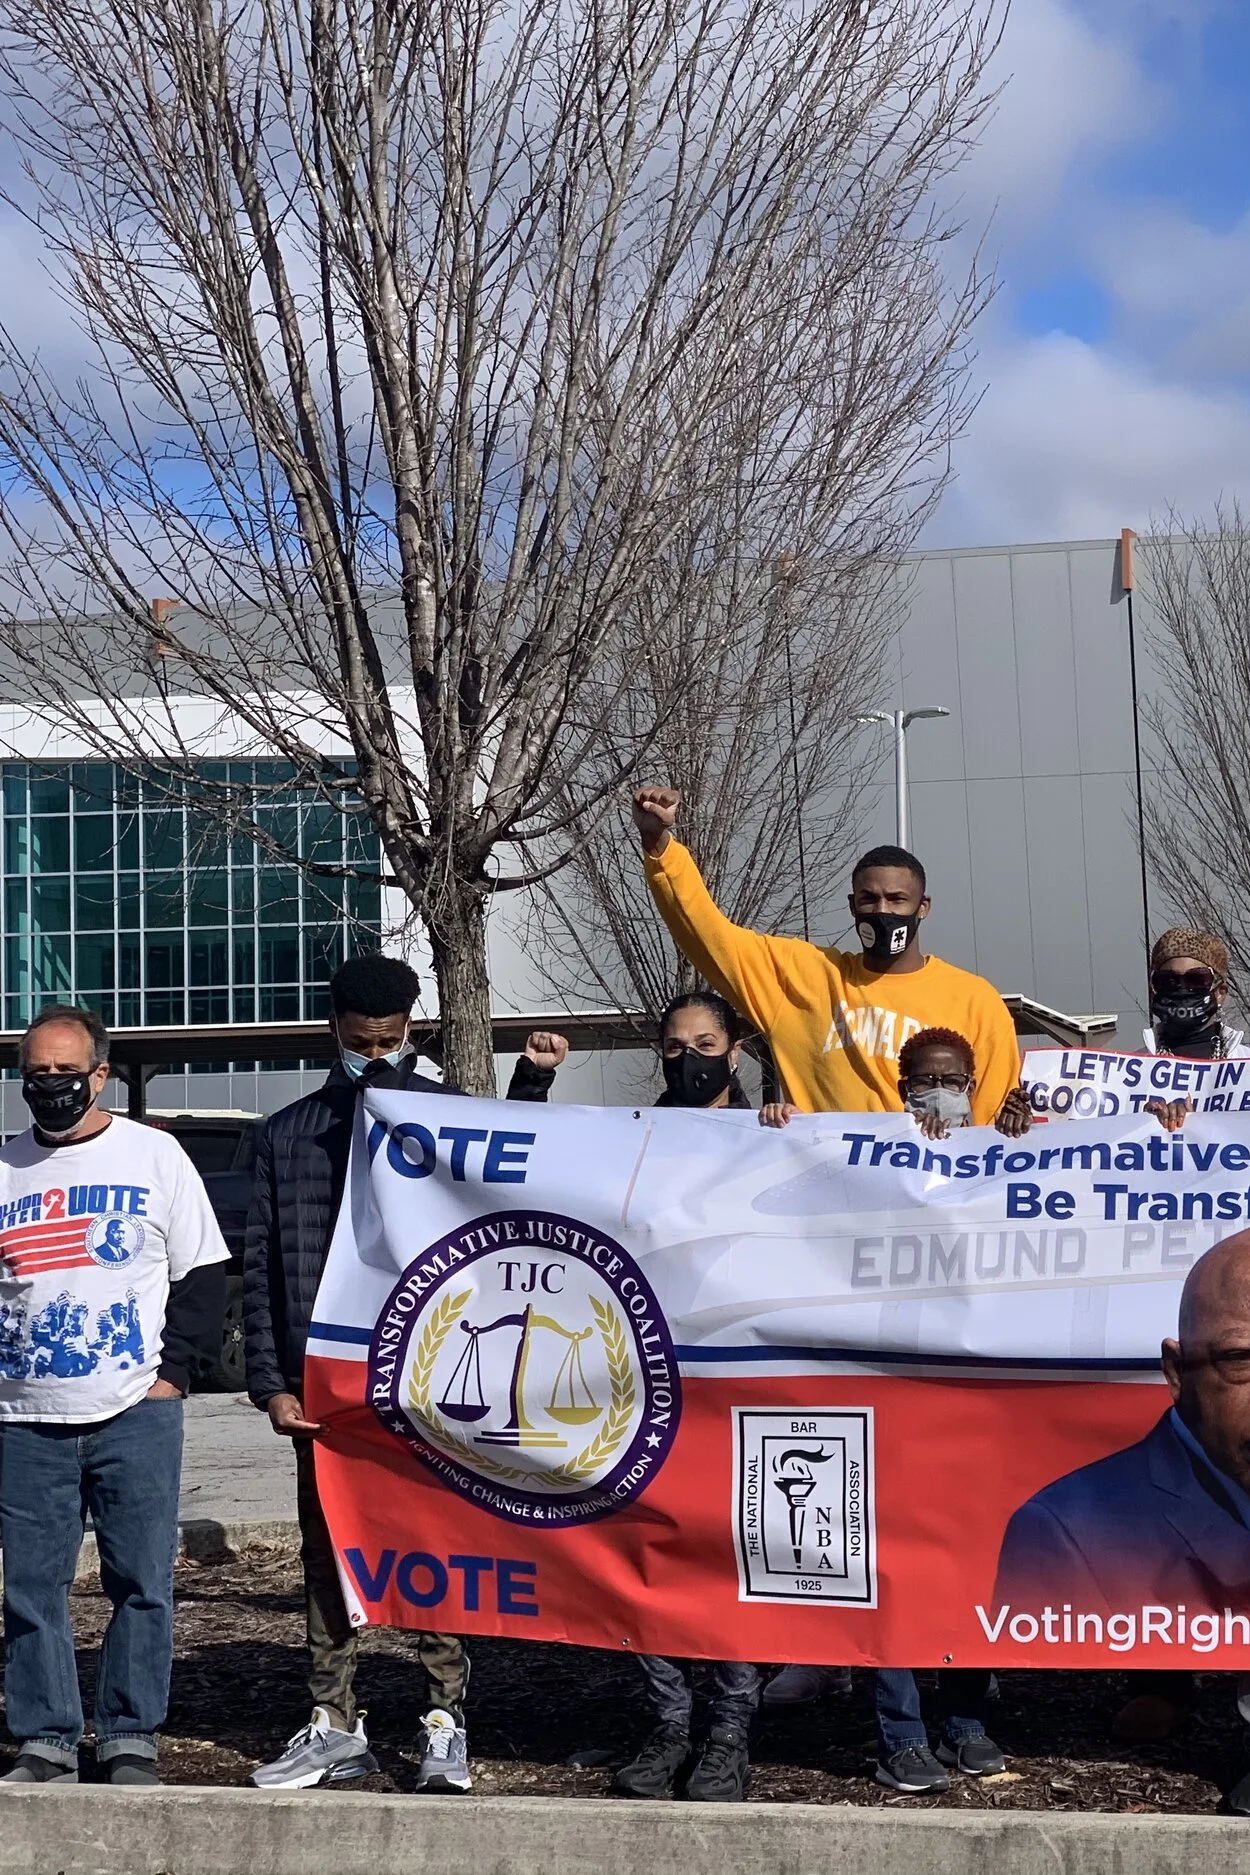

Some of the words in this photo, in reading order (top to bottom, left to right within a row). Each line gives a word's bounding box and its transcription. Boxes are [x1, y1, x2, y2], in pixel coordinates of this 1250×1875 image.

[1167, 1006, 1205, 1019] VOTE
[1059, 1051, 1143, 1088] LET'S
[1150, 1059, 1211, 1092] GET
[1214, 1062, 1246, 1089] IN
[841, 1132, 1250, 1179] Transformative
[1006, 1182, 1076, 1220] Be
[497, 1261, 567, 1294] TJC
[850, 1227, 1088, 1288] EDMUND
[372, 1221, 520, 1416] TRANSFORMATIVE
[524, 1221, 626, 1280] JUSTICE
[620, 1277, 674, 1429] COALITION
[791, 1421, 818, 1433] BAR
[407, 1439, 470, 1490] IGNITING
[472, 1484, 530, 1516] CHANGE
[533, 1507, 545, 1519] &
[547, 1495, 613, 1520] INSPIRING
[609, 1453, 653, 1502] ACTION
[747, 1455, 759, 1528] NATIONAL
[849, 1460, 861, 1557] ASSOCIATION
[748, 1532, 759, 1557] THE
[343, 1546, 540, 1617] VOTE
[794, 1579, 822, 1591] 1925
